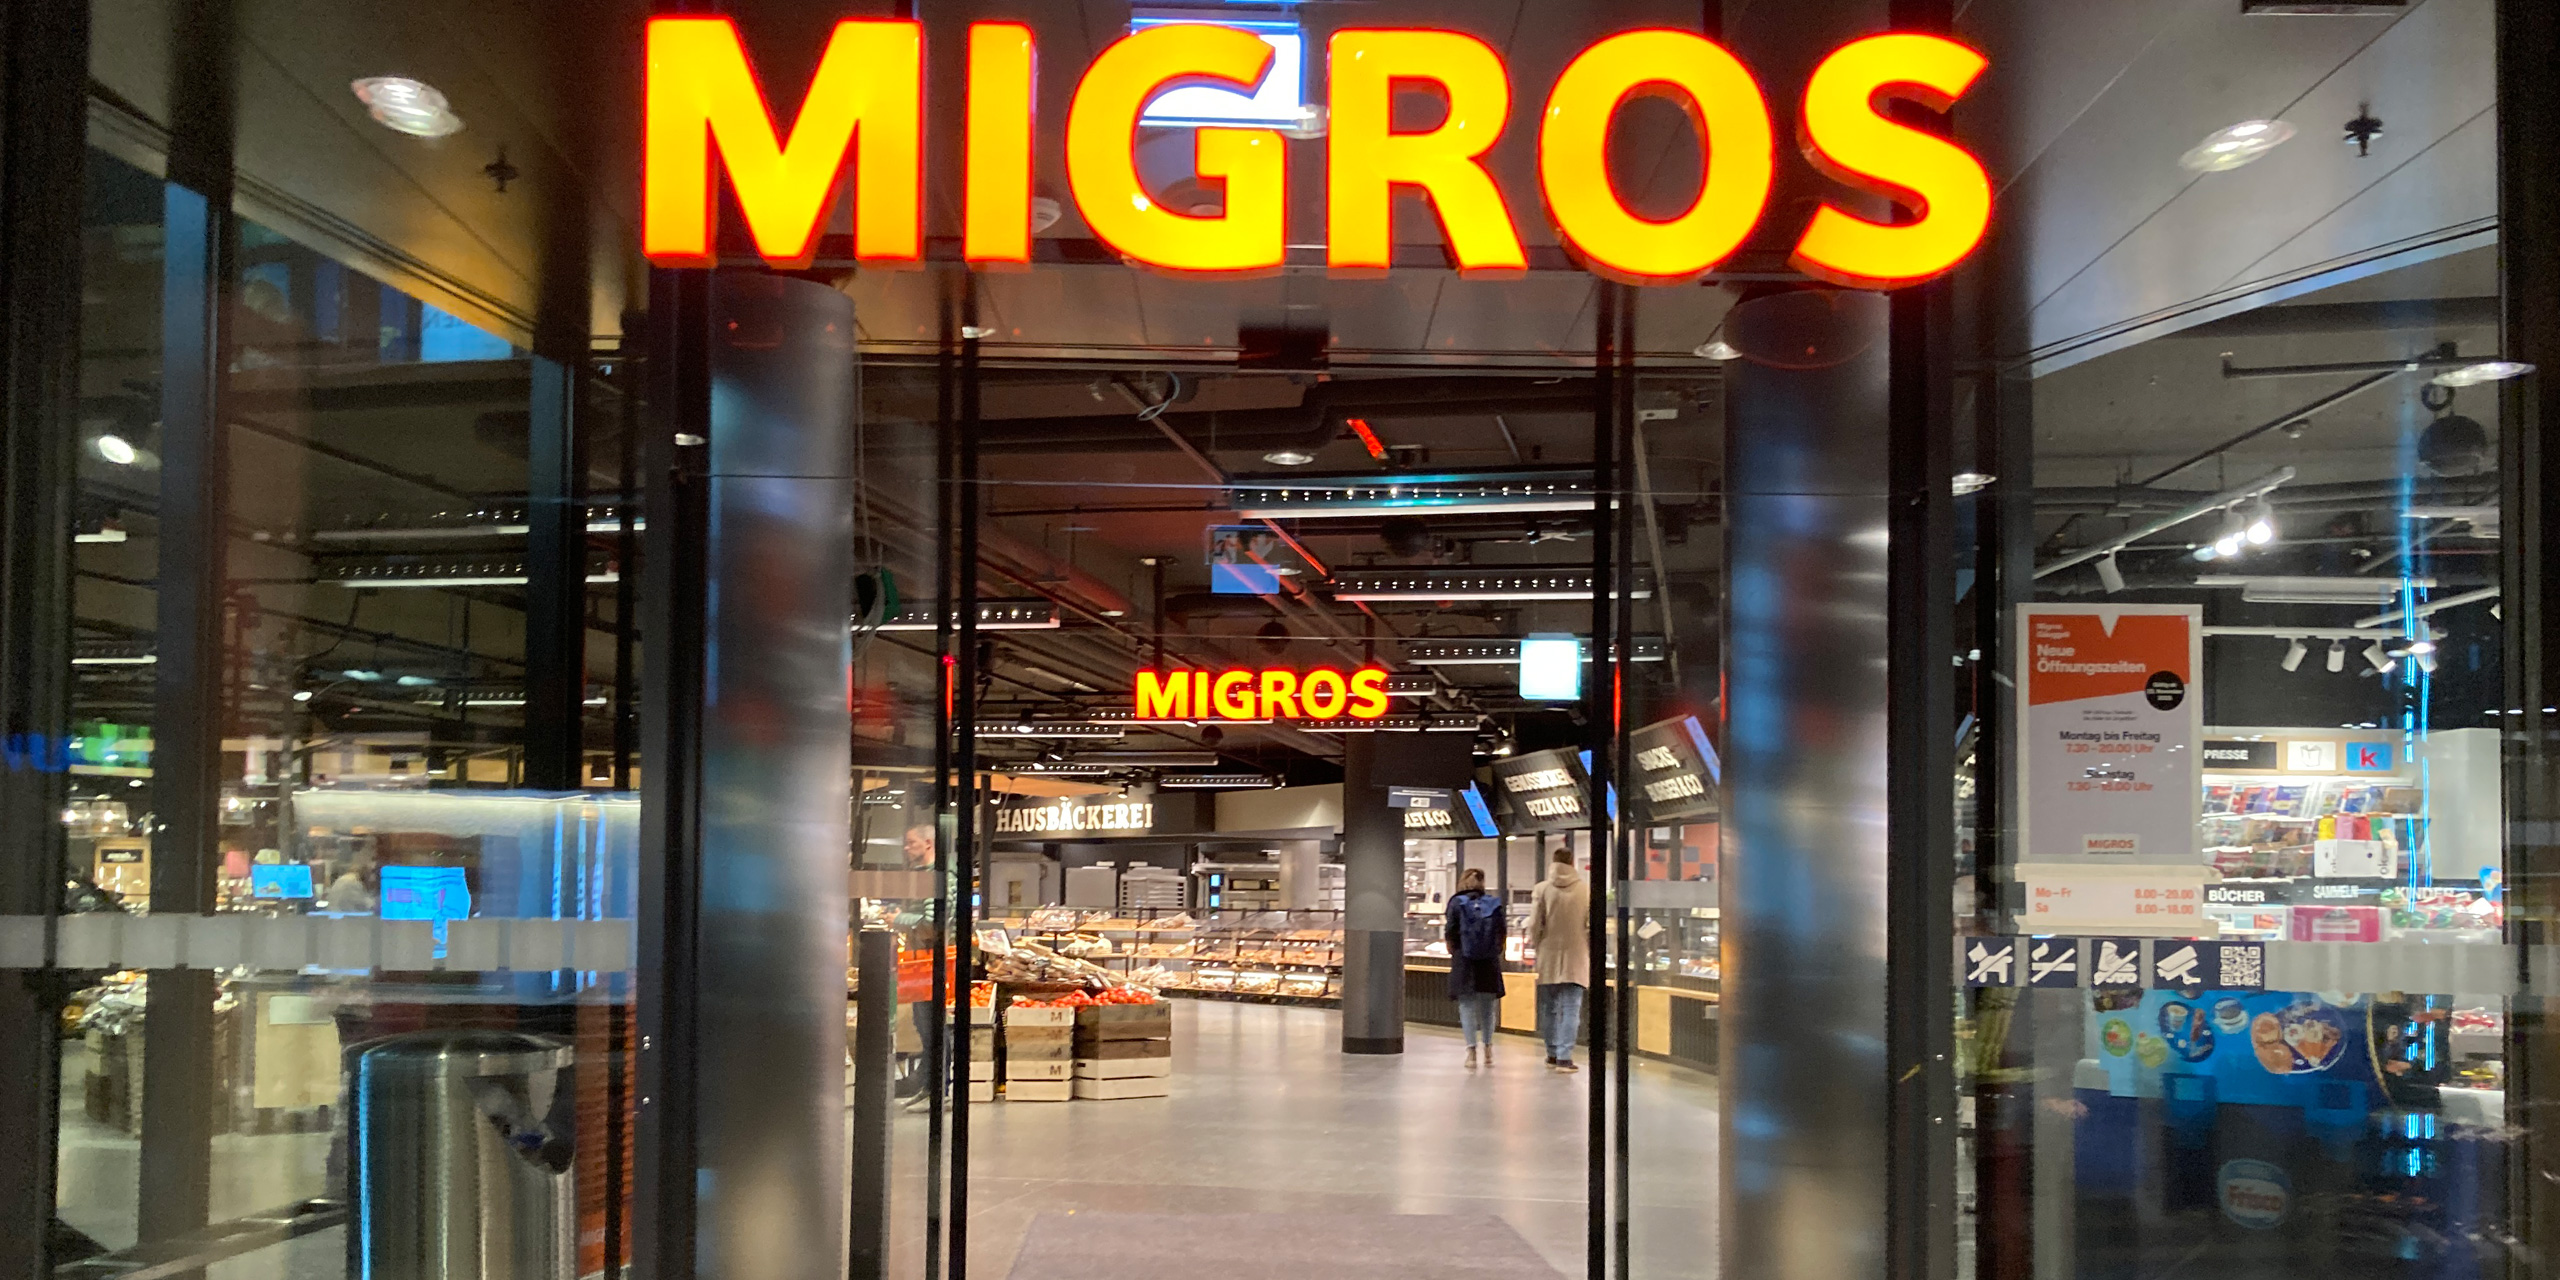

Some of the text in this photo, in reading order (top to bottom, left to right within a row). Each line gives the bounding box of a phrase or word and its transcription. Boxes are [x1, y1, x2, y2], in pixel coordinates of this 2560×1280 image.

[643, 18, 1994, 287] MIGROS
[2036, 644, 2075, 656] Neue
[2036, 657, 2147, 675] Öffnungszeiten
[1134, 667, 1390, 720] MIGROS
[2059, 730, 2161, 743] Montag bis Freitag
[2203, 749, 2249, 760] PRESSE
[996, 801, 1154, 833] HAUSBÄCKEREI
[2087, 839, 2134, 849] MIGROS
[2208, 887, 2265, 902] BÜCHER
[2035, 902, 2049, 913] Sa
